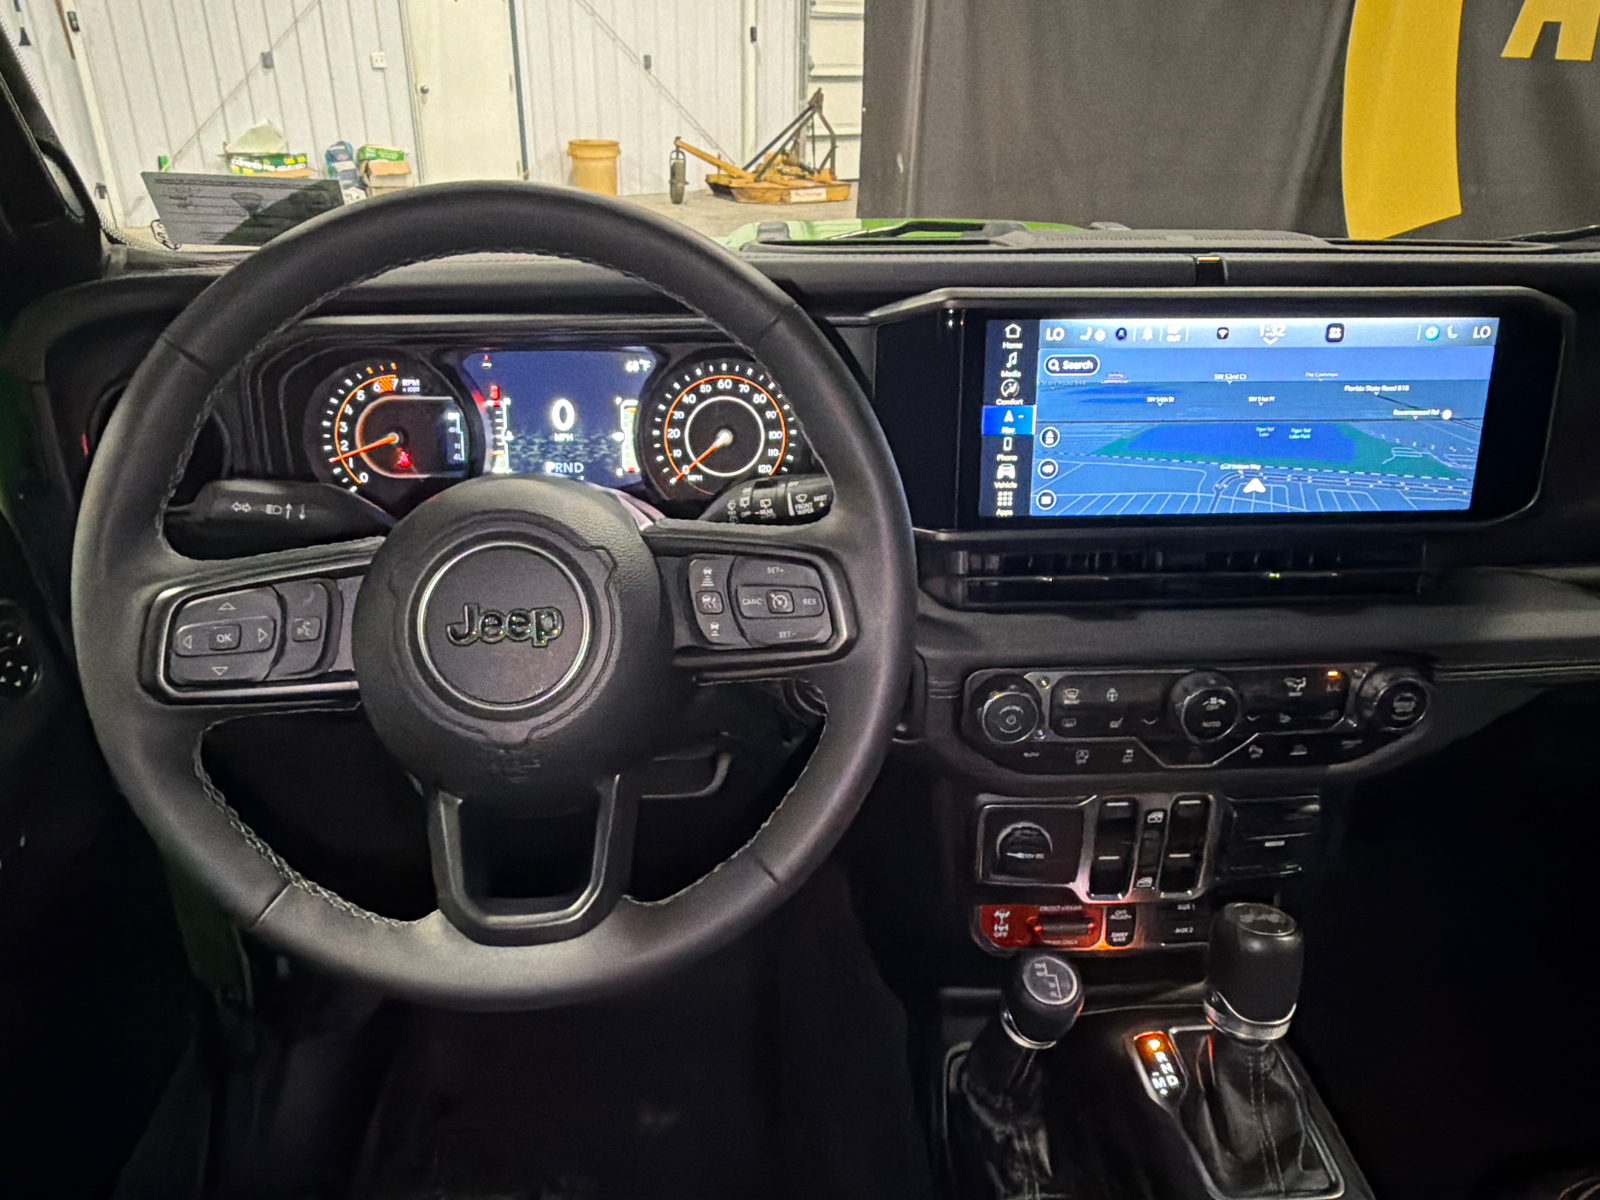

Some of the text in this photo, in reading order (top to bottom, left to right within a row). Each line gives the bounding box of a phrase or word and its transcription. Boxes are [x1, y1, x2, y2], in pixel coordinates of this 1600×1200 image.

[1045, 328, 1065, 341] LO
[1473, 326, 1492, 339] LO
[1002, 341, 1023, 350] Home
[1062, 359, 1094, 371] Search
[1001, 369, 1021, 378] Media
[373, 383, 381, 392] 6
[391, 378, 399, 391] 7
[401, 378, 420, 387] RPM
[717, 379, 732, 389] 60
[700, 384, 712, 393] 50
[739, 384, 750, 393] 70
[356, 390, 366, 401] 5
[682, 394, 697, 404] 40
[753, 394, 767, 404] 80
[996, 398, 1024, 406] Comfort
[344, 403, 354, 415] 4
[552, 399, 575, 431] 0
[673, 411, 684, 419] 30
[765, 411, 777, 419] 90
[339, 421, 348, 433] 3
[1002, 426, 1016, 434] Nav
[667, 428, 680, 438] 20
[768, 431, 782, 440] 100
[340, 440, 349, 451] 2
[672, 449, 682, 458] 10
[768, 448, 779, 457] 110
[996, 454, 1018, 462] Phone
[758, 464, 772, 473] 120
[359, 472, 369, 483] 0
[994, 481, 1018, 489] Vehicle
[996, 509, 1013, 518] Apps
[446, 602, 565, 649] Jeep
[216, 632, 232, 643] OK
[1155, 1051, 1168, 1062] R
[1160, 1062, 1174, 1074] N
[1152, 1076, 1167, 1089] M
[1166, 1075, 1179, 1086] D
